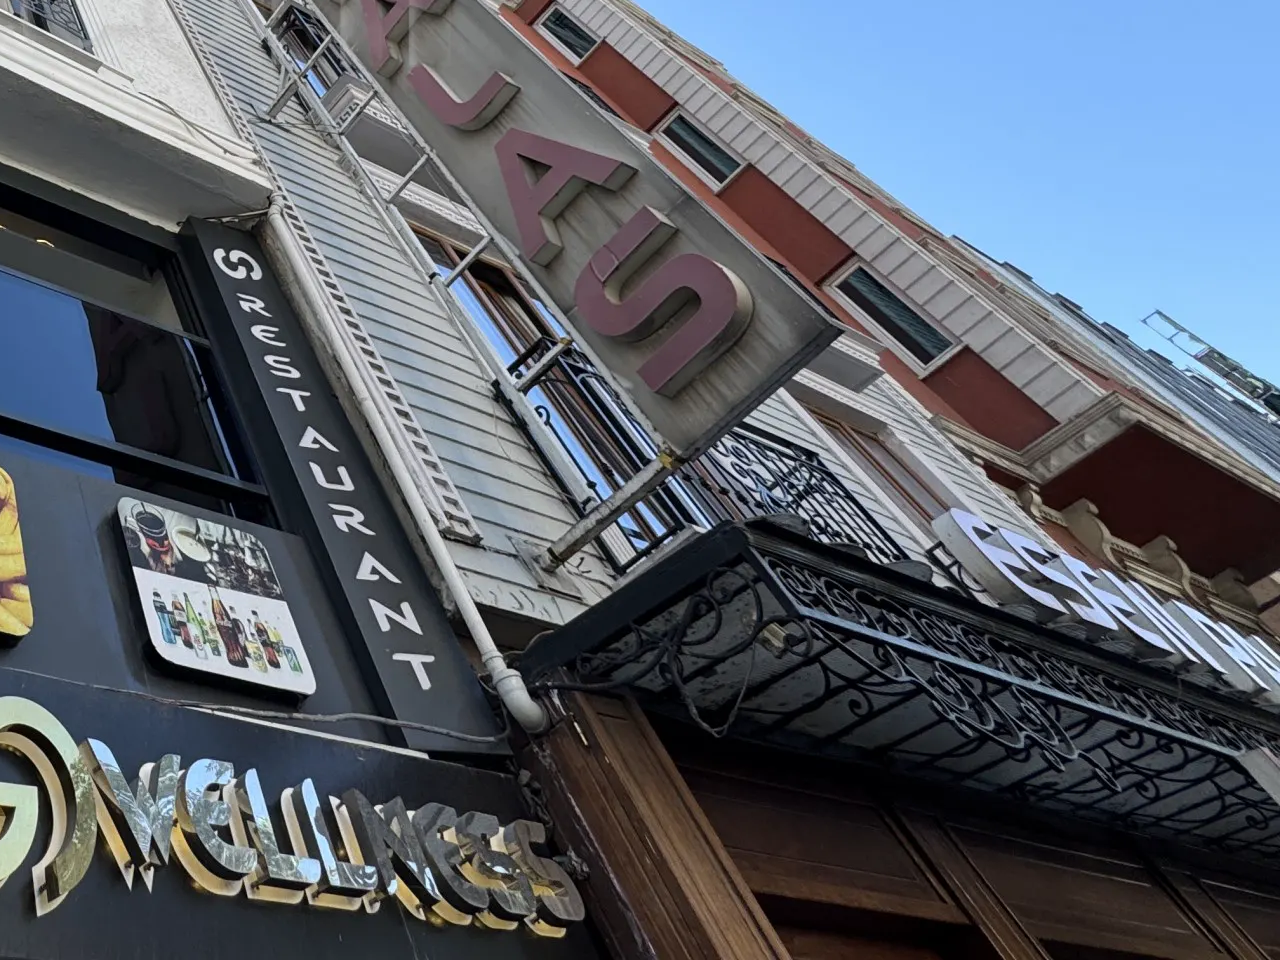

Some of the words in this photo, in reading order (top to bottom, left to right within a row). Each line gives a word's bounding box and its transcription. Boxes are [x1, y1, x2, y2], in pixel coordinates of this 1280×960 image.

[236, 292, 435, 691] RESTAURANT
[940, 507, 1229, 675] ESEN
[1170, 599, 1280, 693] PA
[78, 737, 585, 937] WELLNESS
